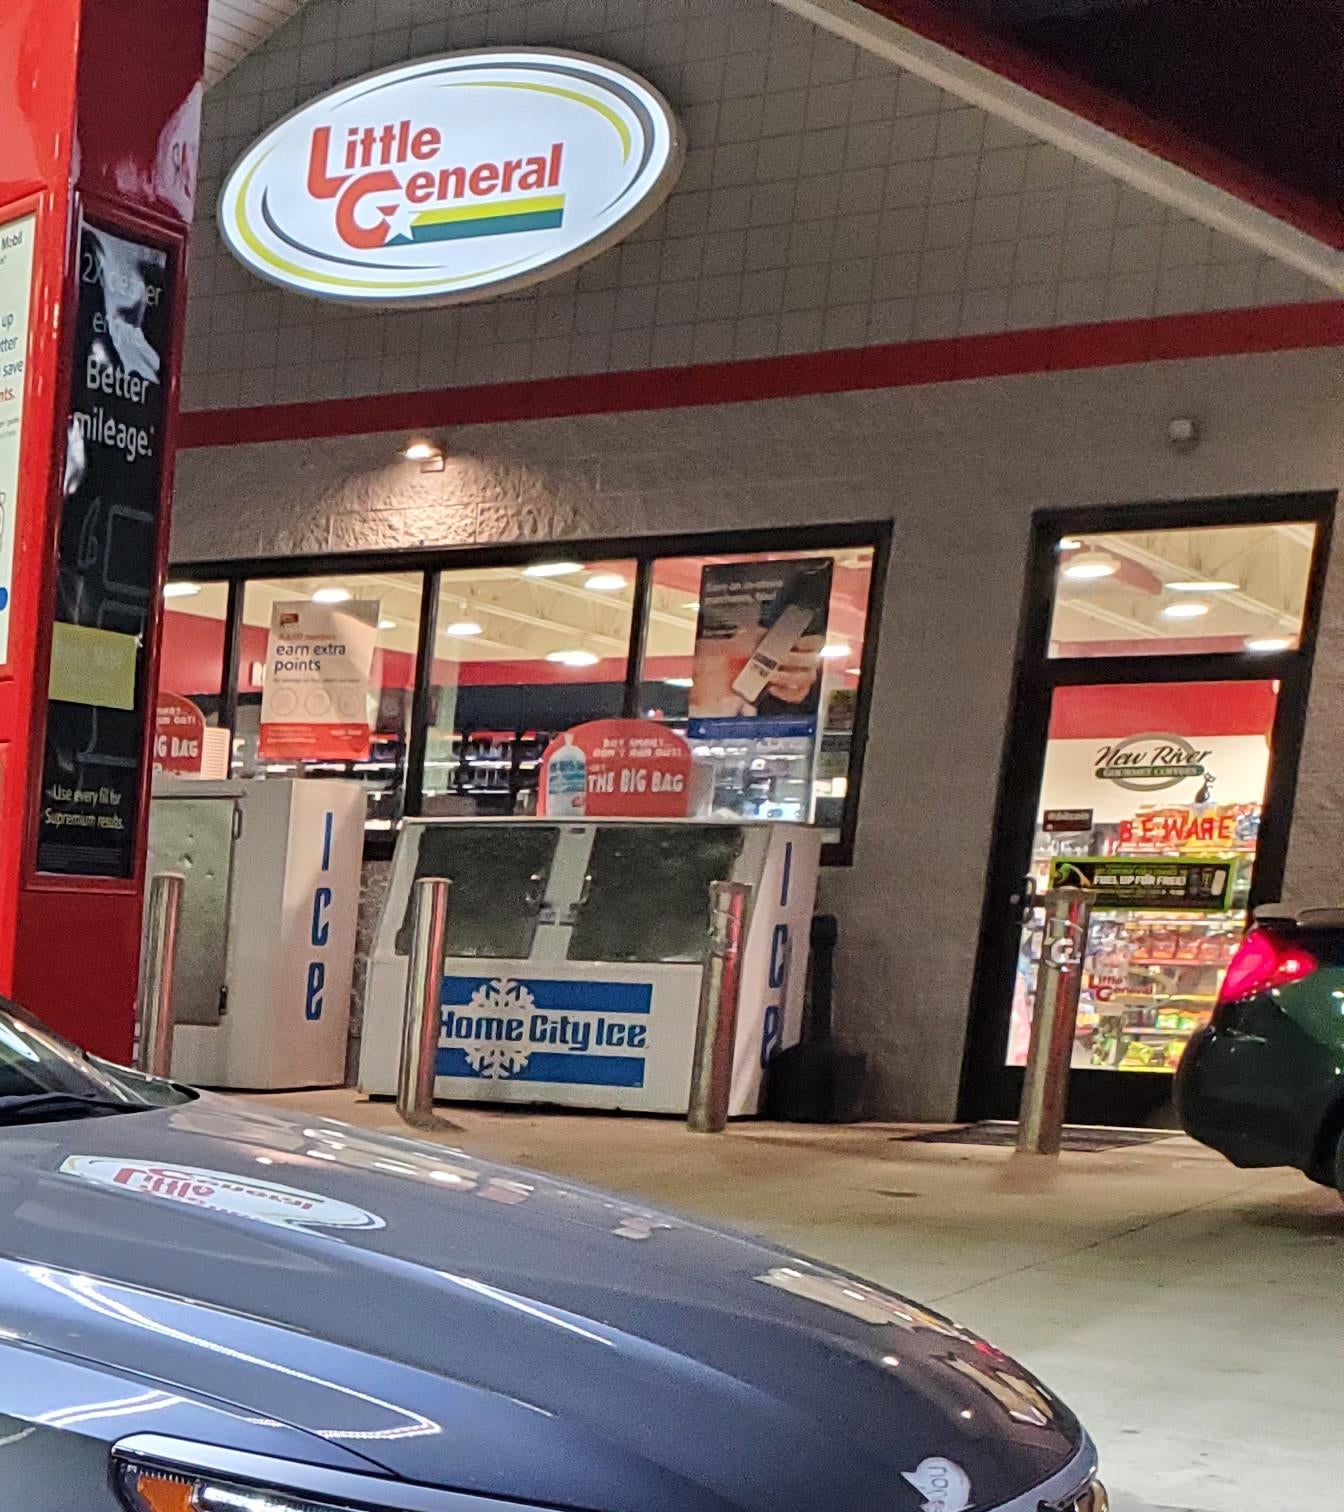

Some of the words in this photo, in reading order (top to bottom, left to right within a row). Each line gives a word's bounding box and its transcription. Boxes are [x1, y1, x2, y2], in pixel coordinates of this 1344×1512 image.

[307, 119, 441, 199] Little
[336, 142, 564, 250] General
[1, 312, 14, 331] up
[3, 360, 24, 377] save
[86, 354, 149, 404] Better
[276, 645, 309, 656] earn
[313, 643, 346, 656] extra
[273, 657, 321, 675] points
[170, 736, 199, 758] BAG
[1095, 745, 1148, 767] New
[1151, 745, 1213, 765] River
[588, 771, 615, 793] THE
[620, 768, 647, 793] BIG
[651, 770, 684, 793] BAG
[52, 783, 72, 801] Use
[74, 789, 97, 808] every
[440, 1010, 524, 1041] Home
[529, 1014, 591, 1052] City
[596, 1017, 647, 1049] Ice
